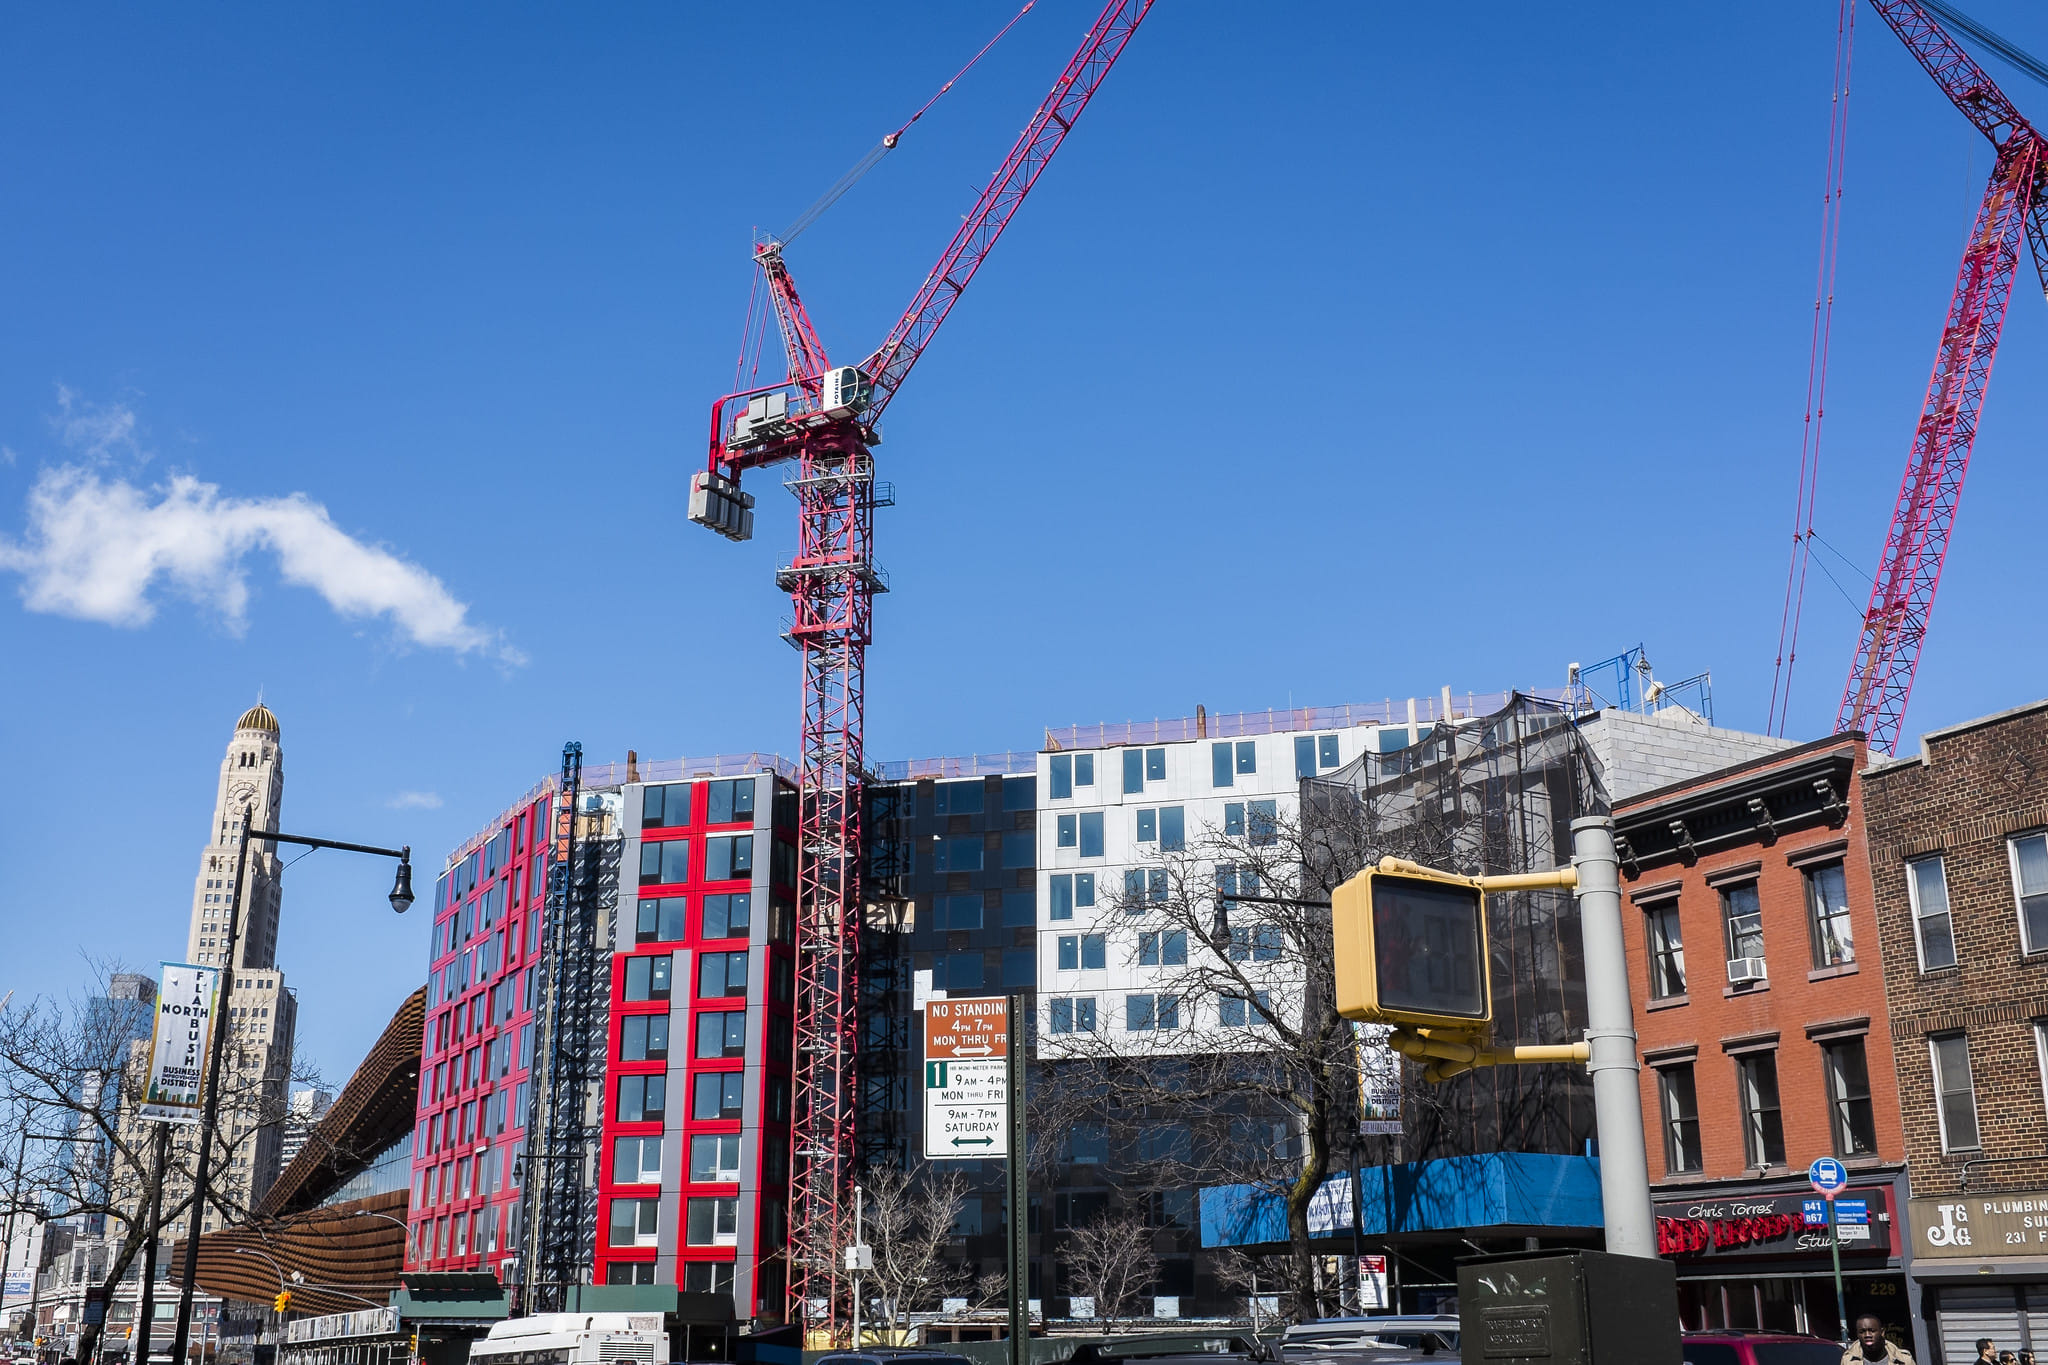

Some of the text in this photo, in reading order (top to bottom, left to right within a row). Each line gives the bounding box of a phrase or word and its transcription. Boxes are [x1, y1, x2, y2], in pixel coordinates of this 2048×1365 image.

[161, 1003, 209, 1018] NORTH
[932, 1002, 1006, 1017] NO STANDIN
[951, 1018, 993, 1032] 4PM 7PM
[933, 1033, 1007, 1046] MON THRU FR
[163, 1066, 201, 1076] BUSINESS
[933, 1062, 940, 1087] 1
[160, 1078, 199, 1088] DISTRICT
[955, 1074, 977, 1086] 9AM
[941, 1091, 964, 1100] MON
[987, 1089, 1004, 1099] FRI
[948, 1109, 968, 1119] 9AM
[977, 1109, 997, 1118] 7PM
[945, 1122, 999, 1133] SATURDAY
[1687, 1204, 1724, 1218] Chris
[1804, 1202, 1821, 1211] B41
[1983, 1200, 2048, 1215] PLUMBIN
[1805, 1213, 1822, 1223] B67
[1657, 1216, 1709, 1254] RED
[2006, 1231, 2026, 1244] 231
[1870, 1283, 1896, 1295] 229
